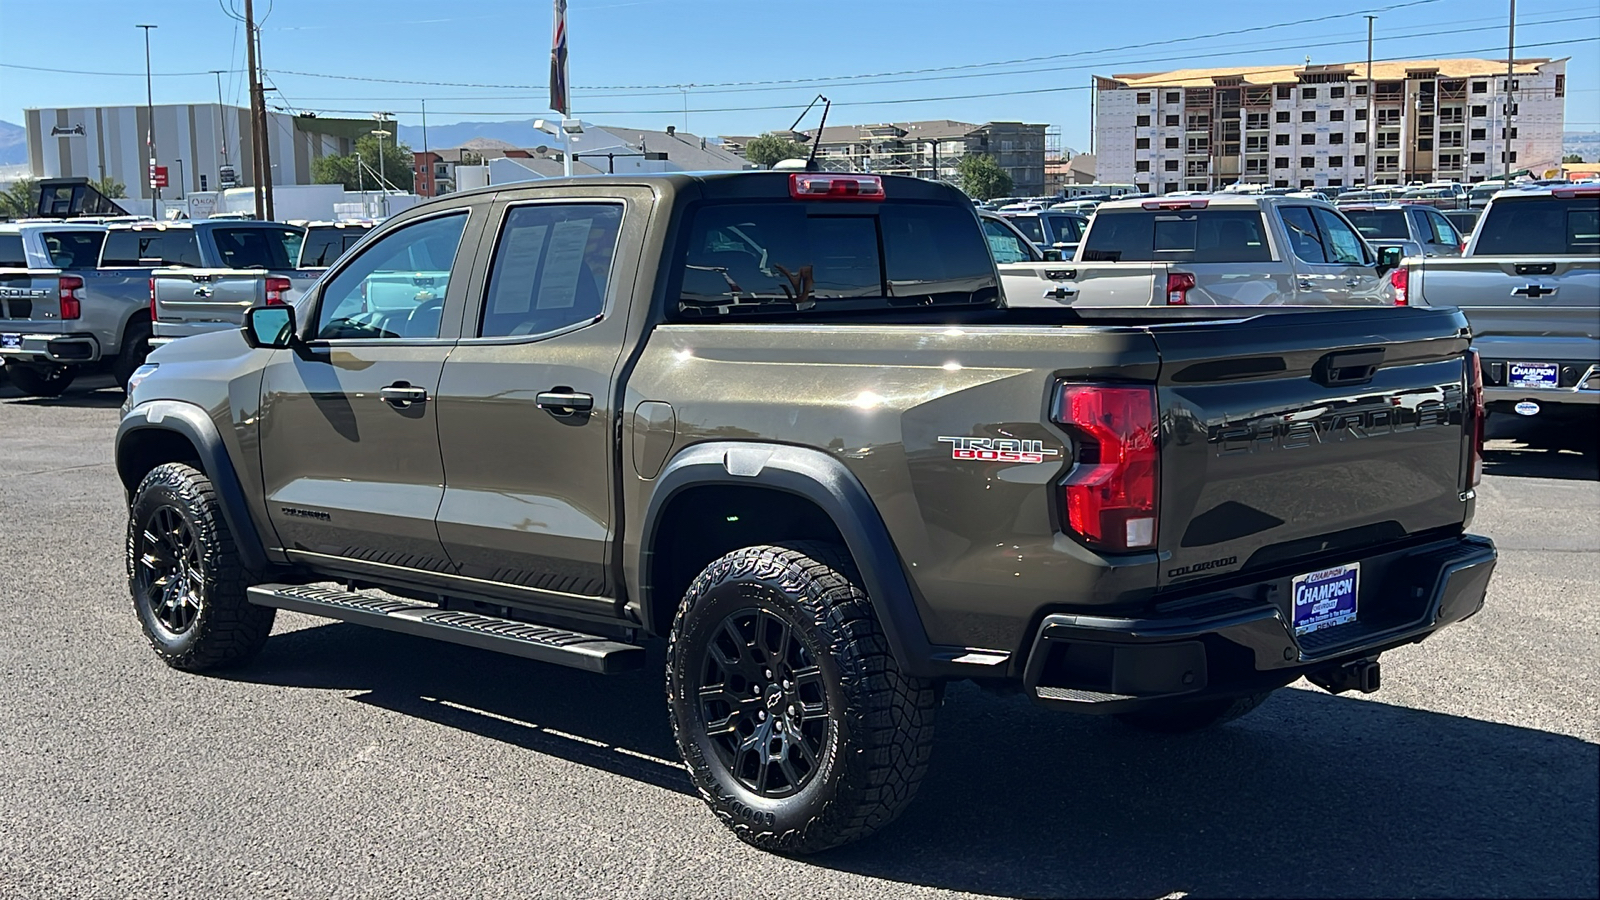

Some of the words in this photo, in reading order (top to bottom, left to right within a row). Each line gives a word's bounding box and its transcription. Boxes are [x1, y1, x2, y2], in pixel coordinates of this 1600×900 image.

[1511, 366, 1555, 376] CHAMPION
[938, 436, 1058, 455] TRAIL
[953, 449, 1042, 463] BOSS
[1168, 556, 1237, 577] COLORADO
[1311, 567, 1344, 580] CHAMPION
[1297, 578, 1353, 606] CHAMPION
